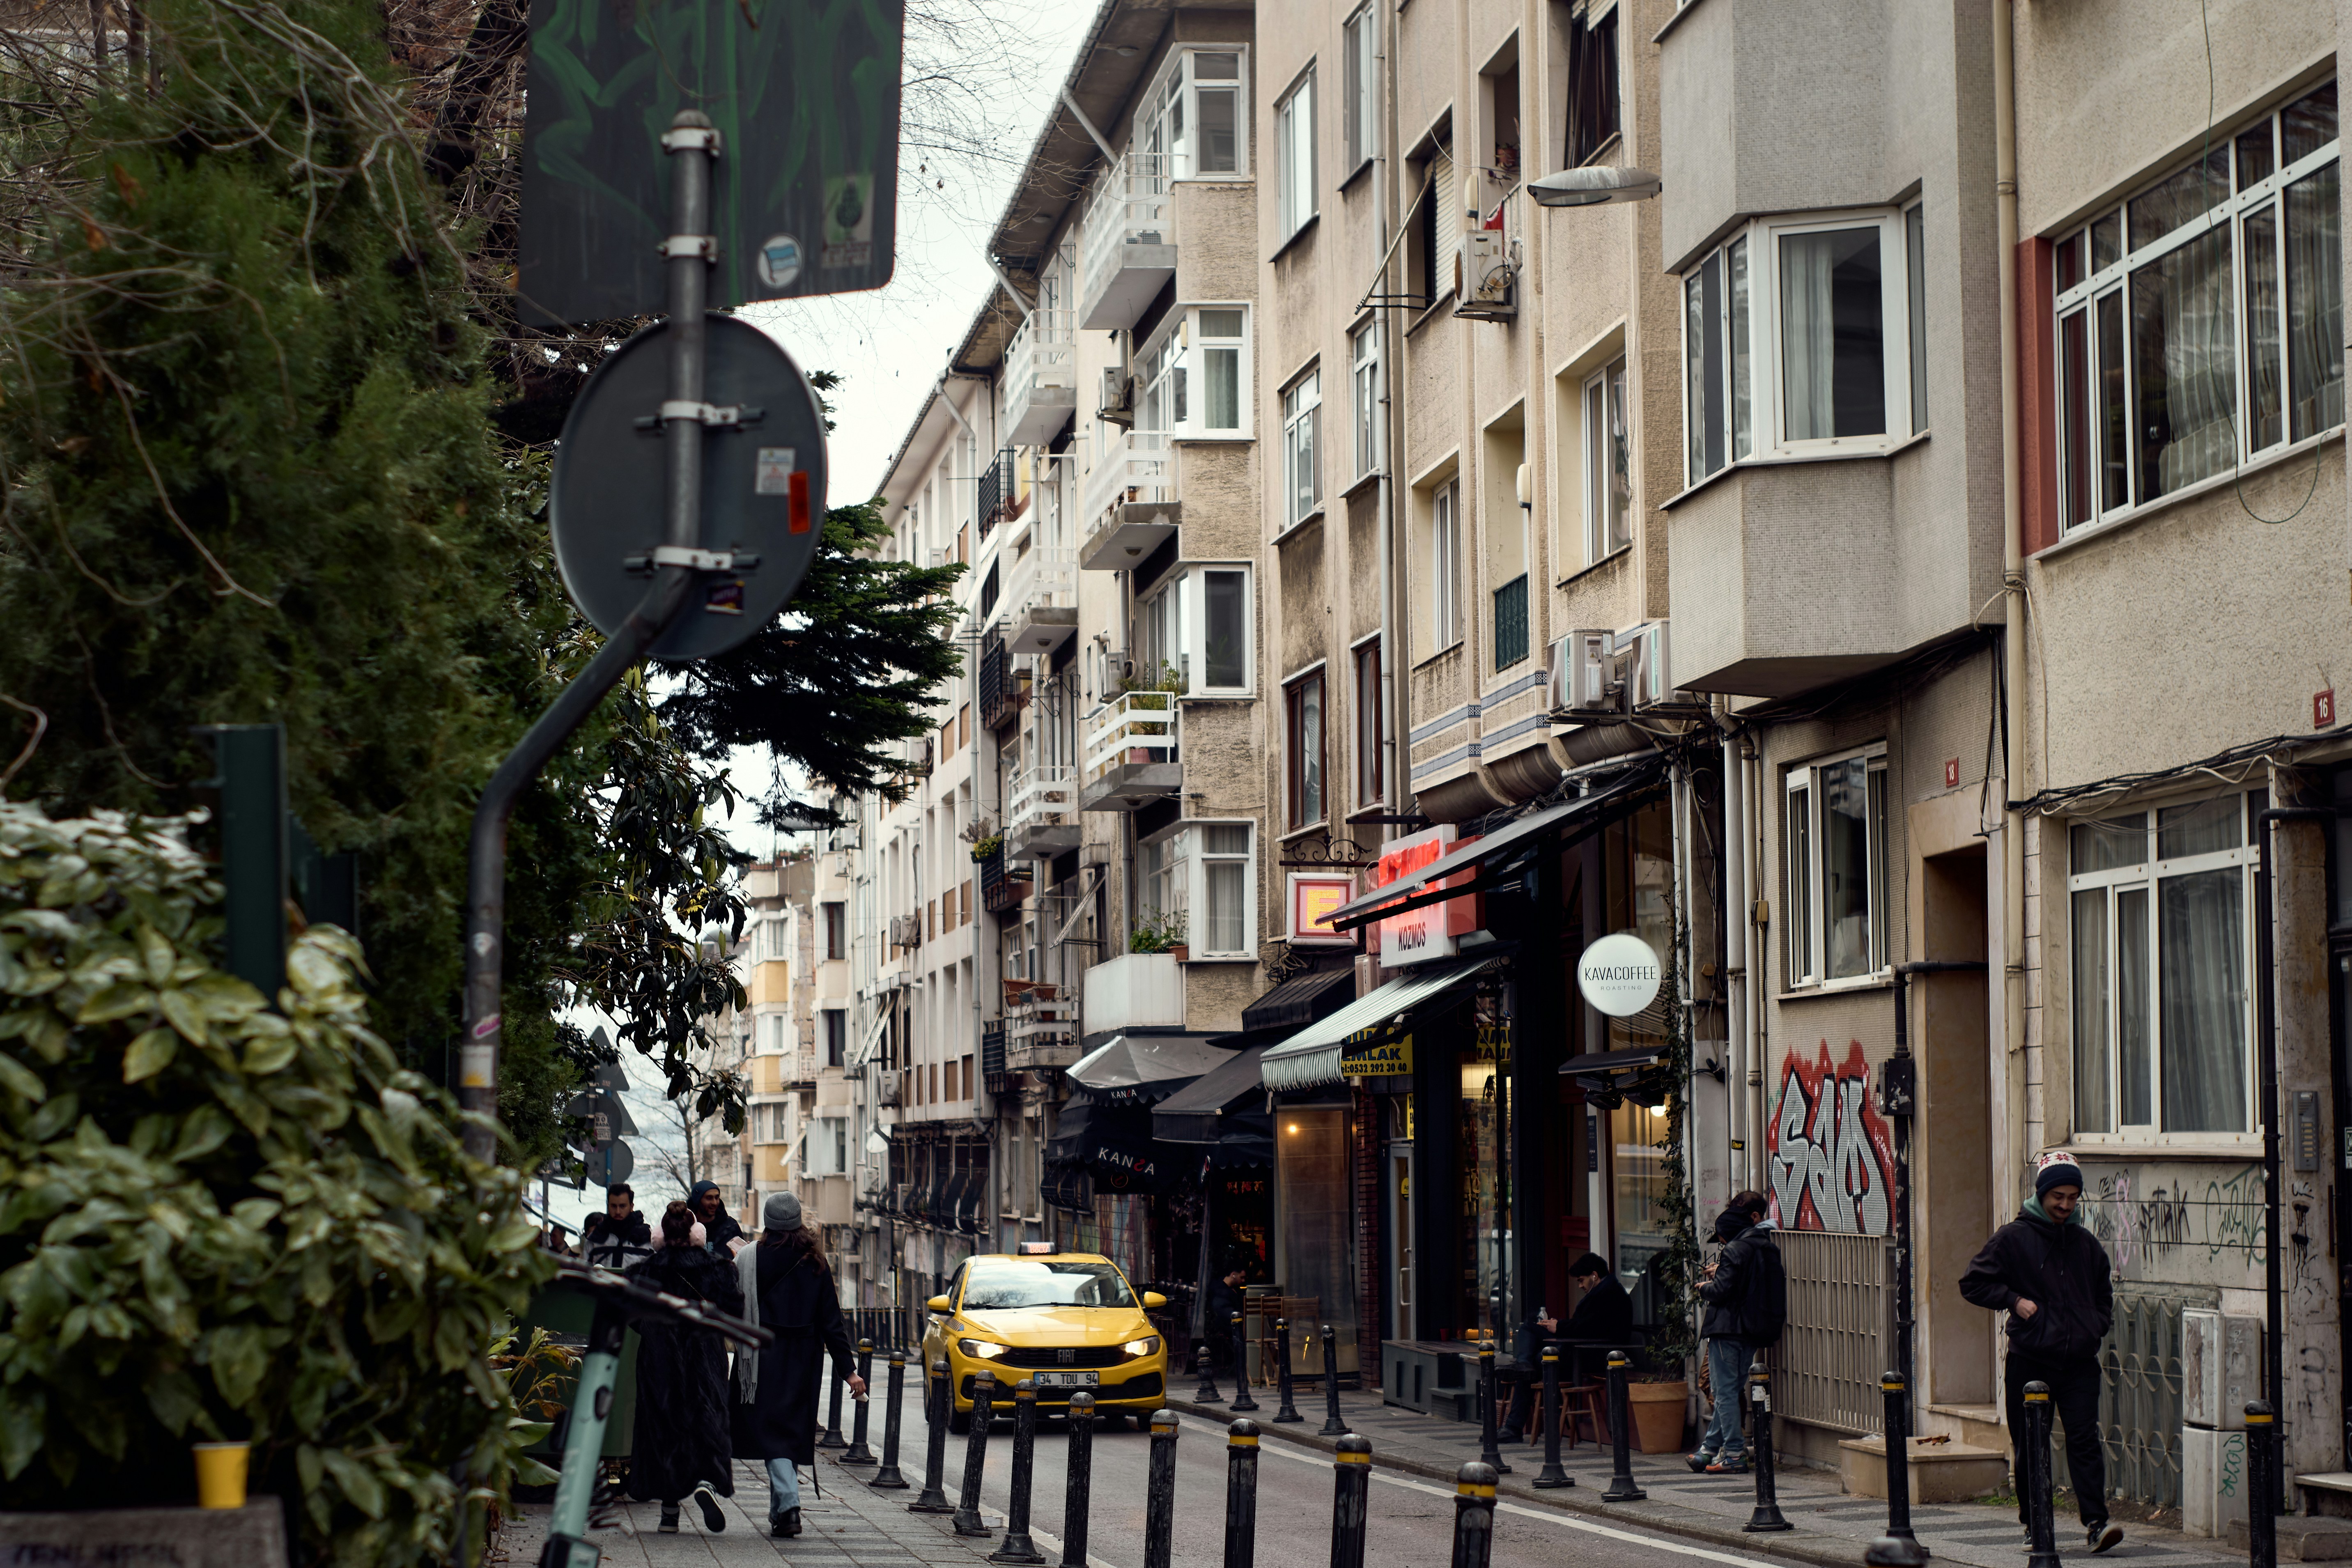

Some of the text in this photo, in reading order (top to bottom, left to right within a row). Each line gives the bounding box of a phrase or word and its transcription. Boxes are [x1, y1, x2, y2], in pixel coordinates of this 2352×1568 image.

[2319, 697, 2328, 719] 16
[1948, 764, 1954, 781] 18
[1399, 921, 1426, 951] KOZMOS
[1585, 966, 1656, 980] KAVACOFFEE
[1370, 1063, 1384, 1072] 292
[1387, 1063, 1396, 1072] 30
[1398, 1063, 1407, 1072] 40
[1058, 1350, 1075, 1363] FIAT
[1040, 1374, 1097, 1384] 34 TDU 94
